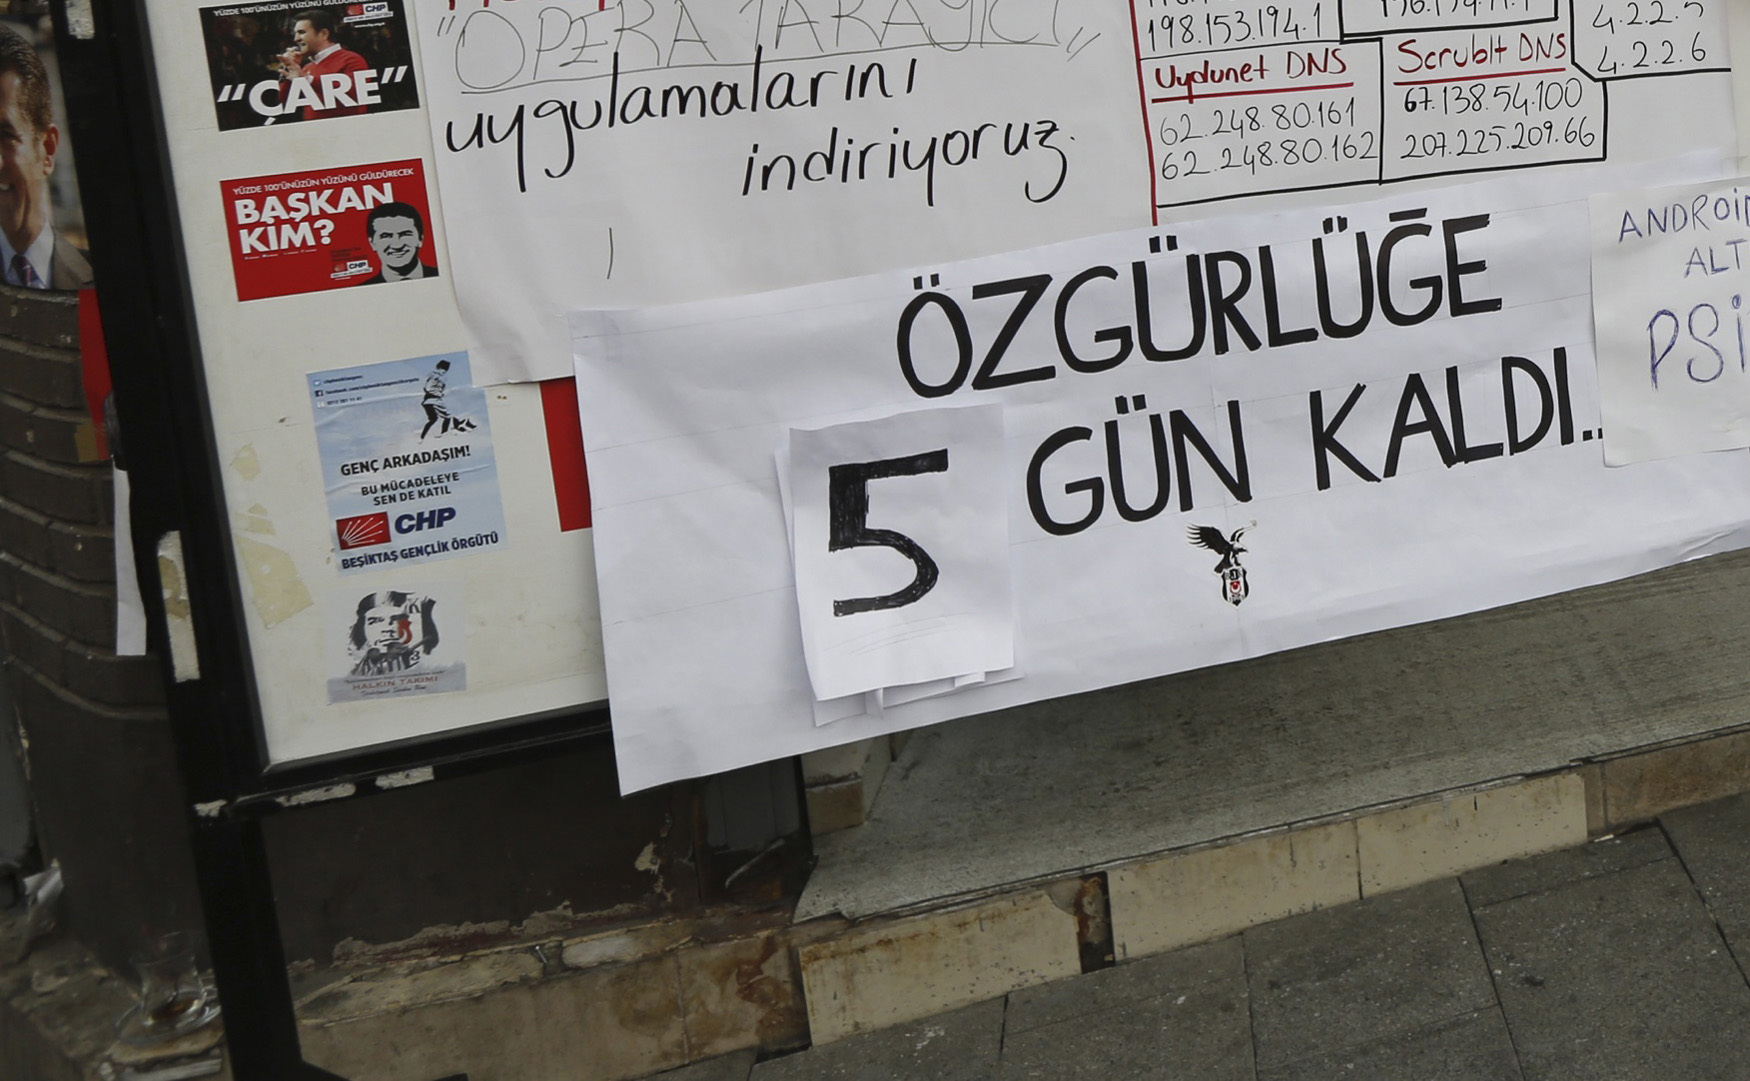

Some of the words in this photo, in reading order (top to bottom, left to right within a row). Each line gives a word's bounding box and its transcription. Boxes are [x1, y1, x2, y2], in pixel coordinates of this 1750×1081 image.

[365, 3, 386, 14] CHP
[1287, 47, 1347, 79] DNS
[1518, 32, 1567, 61] DNS
[1598, 32, 1707, 74] 4.2.2.6
[446, 44, 917, 193] uygulamalarını
[234, 182, 395, 225] BAŞKAN
[239, 218, 335, 255] KİM?
[898, 206, 1504, 399] ÖZGÜRLÜĞE
[340, 459, 380, 476] GENÇ
[382, 445, 471, 470] ARKADAŞIM!
[1026, 394, 1253, 536] GÜN
[361, 486, 378, 497] BU
[380, 471, 460, 492] MÜCADELEYE
[373, 496, 397, 506] SEN
[400, 491, 415, 502] DE
[418, 485, 451, 499] KATIL
[395, 506, 456, 534] CHP
[828, 448, 949, 618] 5
[341, 551, 399, 569] BEŞİKTAŞ
[400, 540, 450, 560] GENÇLİK
[451, 531, 499, 551] ÖRGÜTÜ
